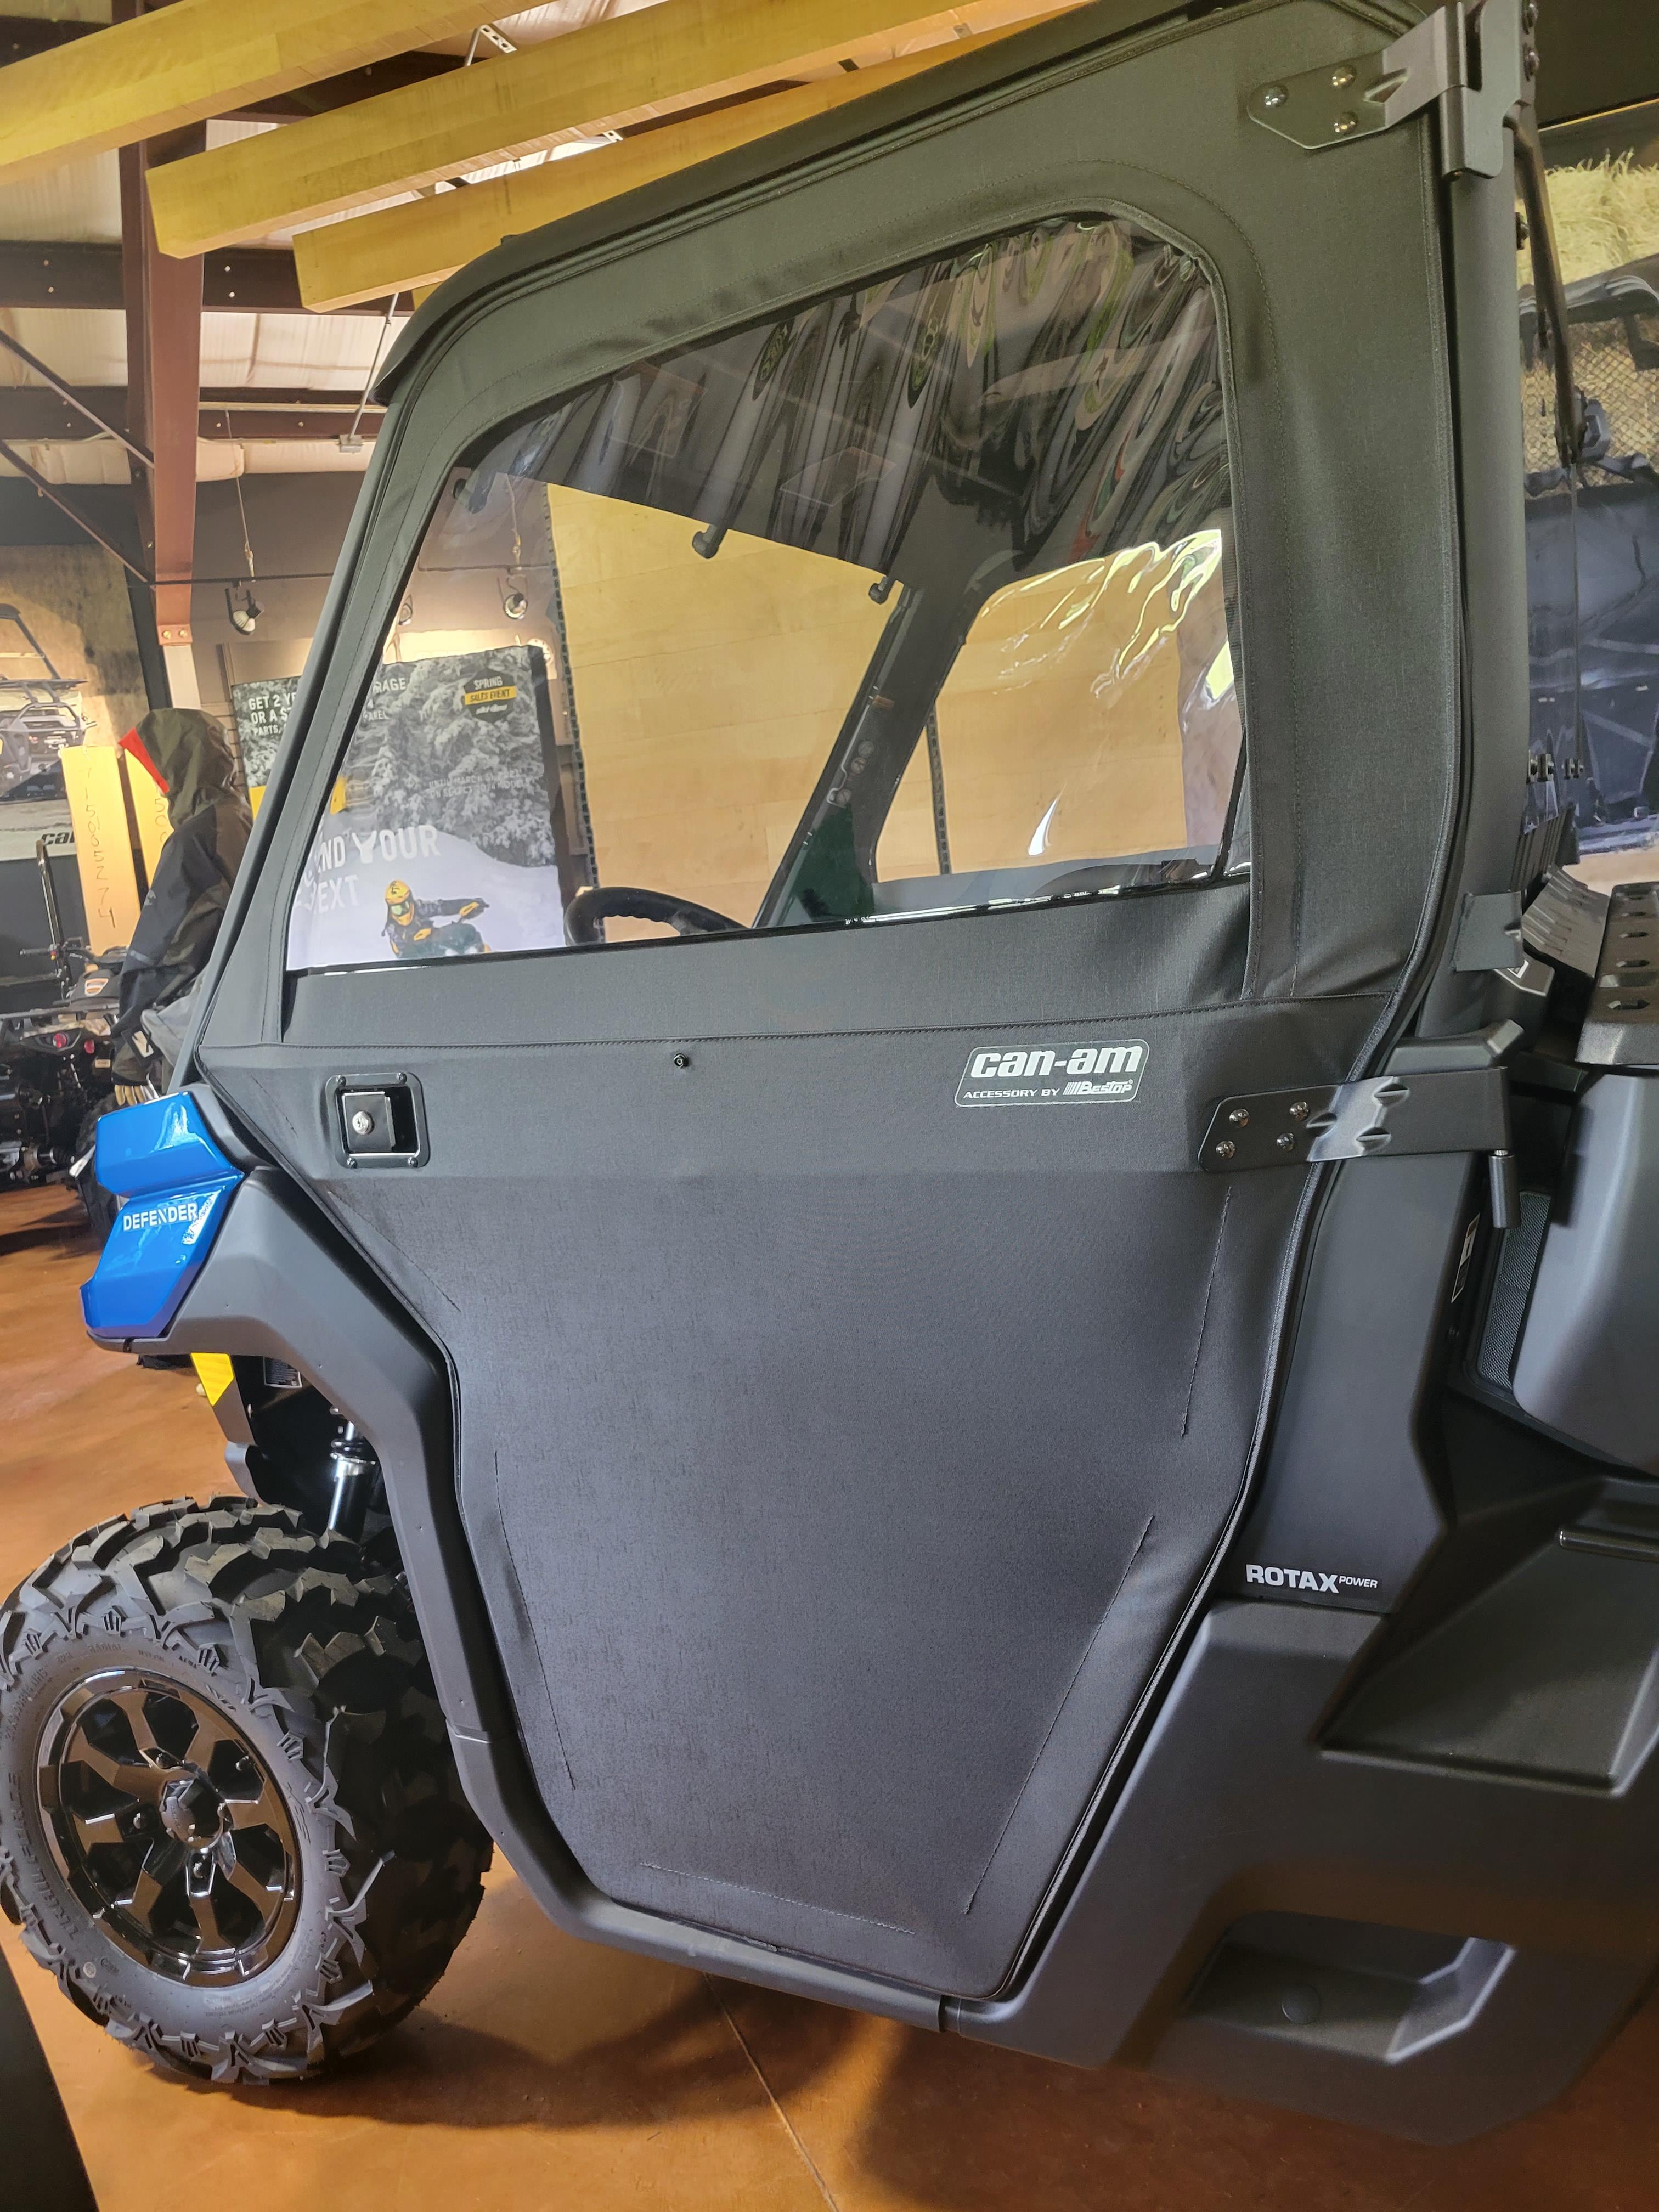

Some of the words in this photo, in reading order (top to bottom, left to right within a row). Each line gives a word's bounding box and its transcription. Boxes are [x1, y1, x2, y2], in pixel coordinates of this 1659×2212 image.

[473, 676, 503, 690] SPRING
[248, 696, 269, 710] GET
[272, 694, 281, 707] 2
[470, 692, 488, 703] SALES
[490, 689, 510, 699] EVENT
[251, 711, 267, 725] OR
[269, 709, 278, 723] A
[253, 724, 281, 736] PARTS,
[352, 825, 441, 864] YOUR
[970, 1046, 1143, 1078] can-am
[963, 1089, 1038, 1099] ACCESSORY
[1041, 1088, 1060, 1097] BY
[123, 1203, 198, 1231] DEFENDER
[1246, 1564, 1339, 1593] ROTAX
[1339, 1575, 1378, 1588] POWER
